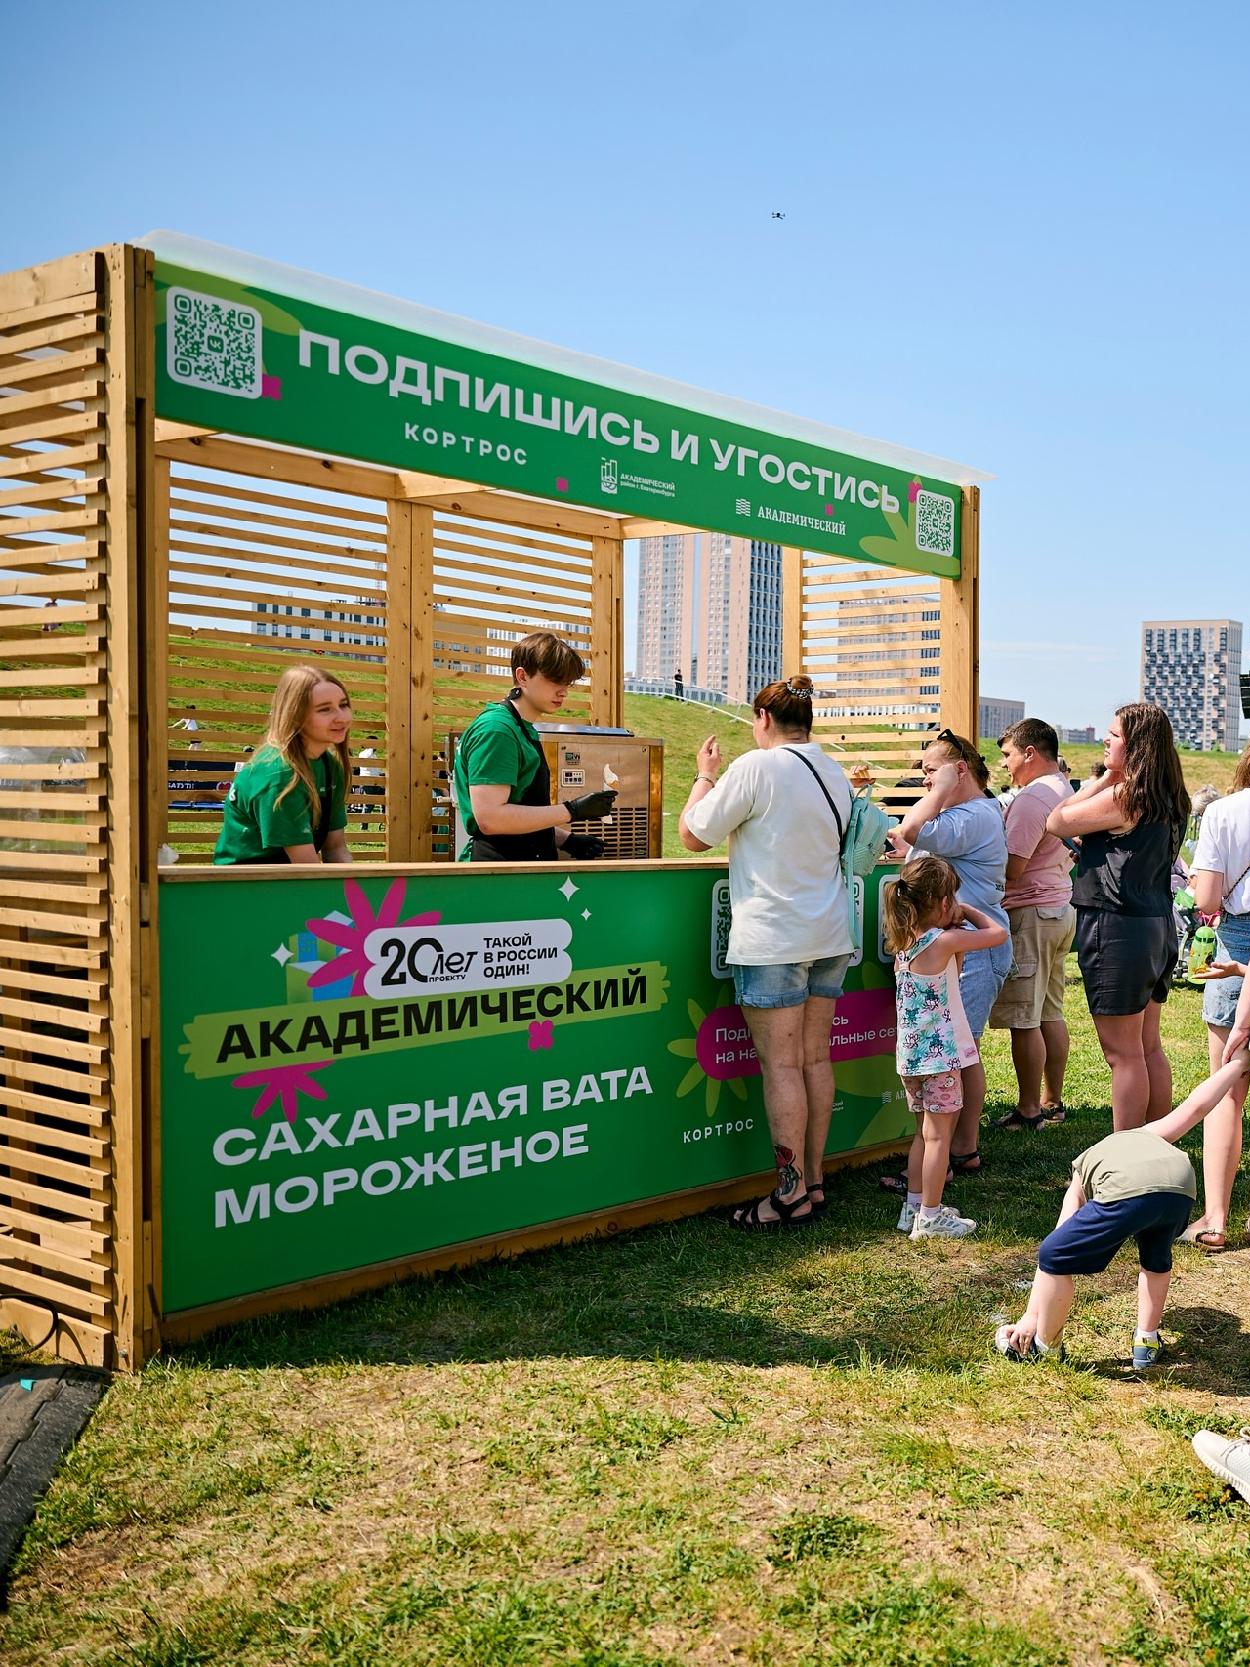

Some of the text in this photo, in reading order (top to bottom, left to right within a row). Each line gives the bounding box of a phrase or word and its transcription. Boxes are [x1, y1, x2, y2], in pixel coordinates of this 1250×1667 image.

[299, 329, 900, 514] ПОДПИШИСЬ И УГОСТИСЬ
[405, 423, 527, 465] КОРТРОС
[620, 473, 676, 491] АКАДЕМИЧЕСКИЙ
[757, 505, 847, 536] АКАДЕМИЧЕСКИЙ
[484, 932, 532, 949] ТАКОЙ
[484, 948, 558, 964] В РОССИИ
[483, 963, 530, 980] ОДИН!
[216, 968, 648, 1064] АКАДЕМИЧЕСКИЙ
[716, 1051, 735, 1064] на
[739, 1048, 758, 1060] на
[213, 1066, 653, 1166] САХАРНАЯ ВАТА
[682, 1117, 755, 1144] КОРТРОС
[215, 1124, 589, 1228] МОРОЖЕНОЕ
